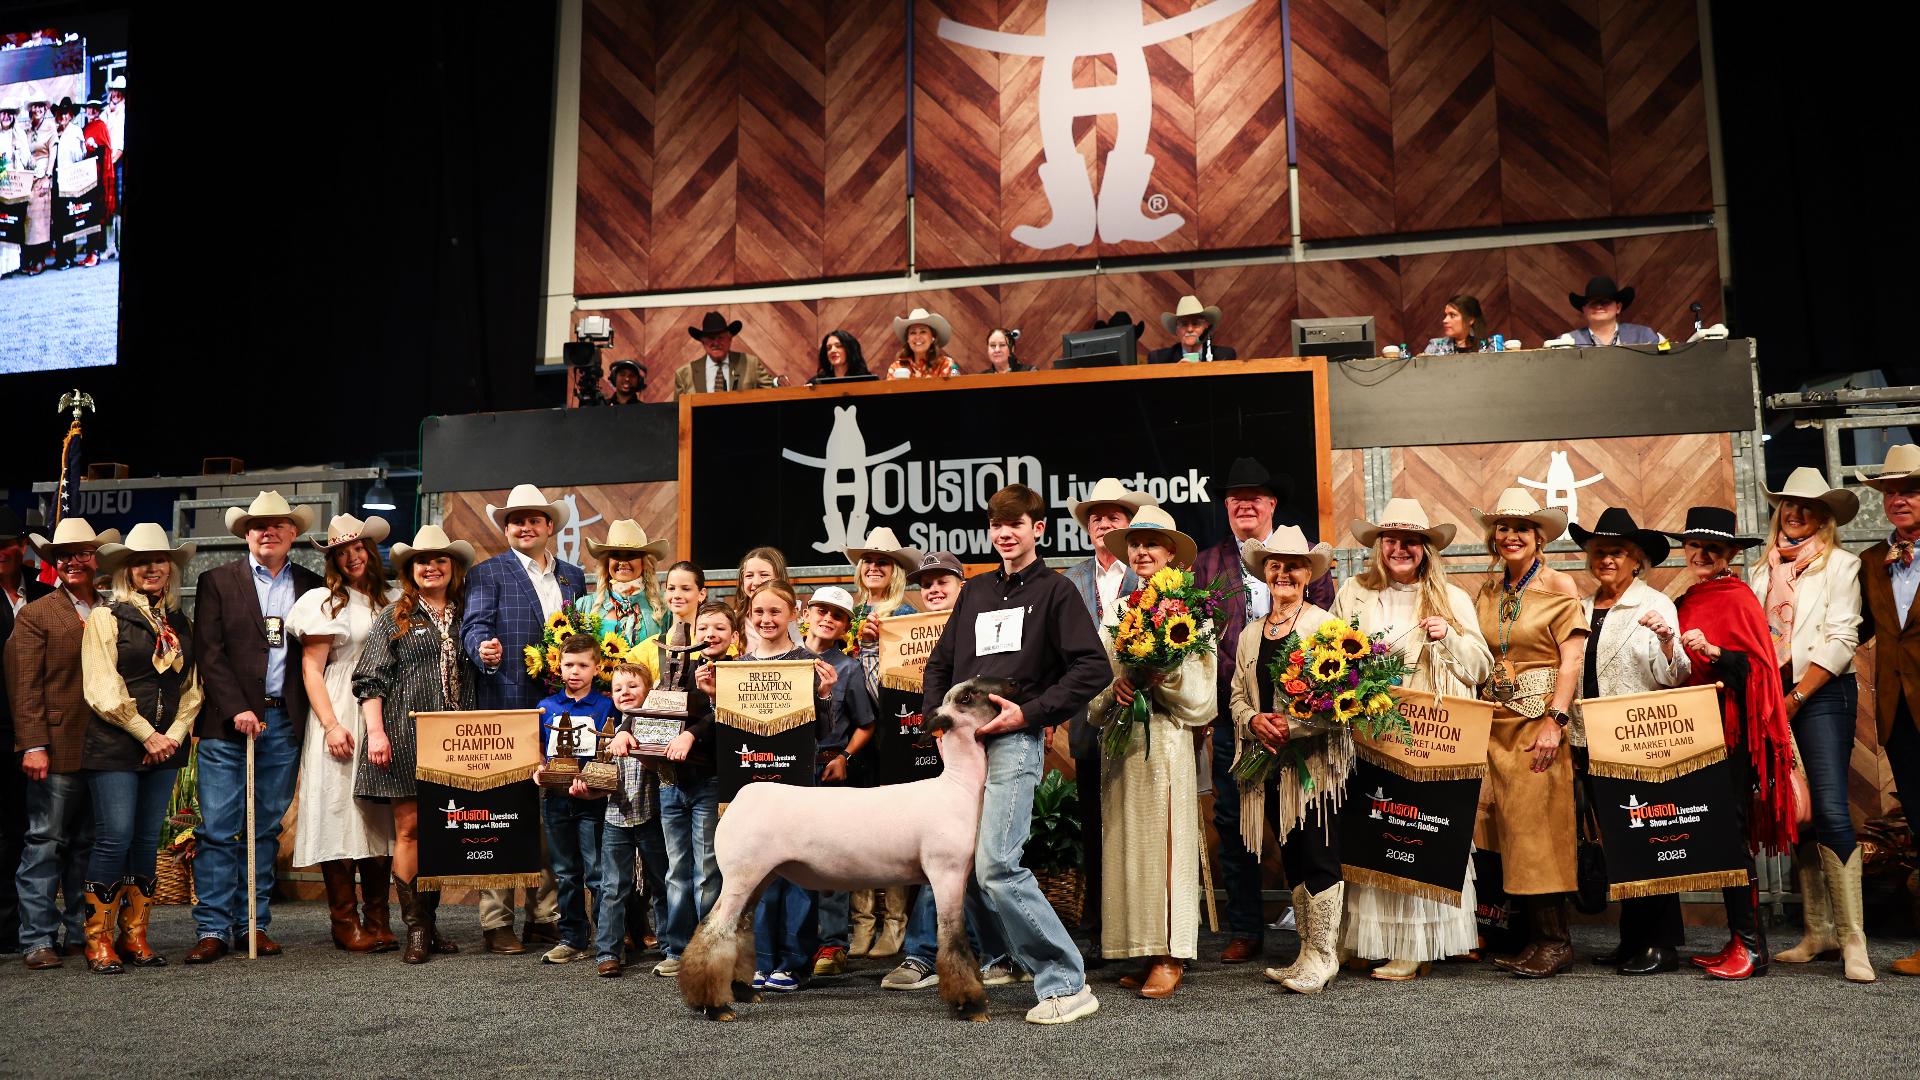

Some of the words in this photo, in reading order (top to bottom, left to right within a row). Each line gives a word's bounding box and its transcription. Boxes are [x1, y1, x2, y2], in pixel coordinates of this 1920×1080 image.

[1050, 469, 1211, 508] Livstock
[80, 489, 132, 514] DEO
[909, 521, 992, 556] Show
[910, 624, 947, 640] GRAN
[899, 640, 938, 656] CHAM
[911, 656, 928, 666] MAR
[749, 671, 782, 682] BREED
[738, 681, 793, 692] CHAMPION
[737, 693, 769, 702] MEDIUM
[770, 692, 793, 701] WOOL
[1397, 702, 1450, 724] GRAND
[1626, 704, 1678, 723] GRAND
[455, 723, 502, 737] GRAND
[1406, 719, 1462, 743] MPION
[1614, 717, 1695, 741] CHAMPION
[442, 736, 515, 752] CHAMPION
[1383, 733, 1395, 744] JR.
[1396, 735, 1430, 749] MRKET
[1430, 741, 1457, 755] LAMB
[1620, 743, 1633, 753] JR.
[1633, 738, 1669, 752] MARKET
[1669, 736, 1695, 748] LAMB
[445, 754, 456, 763] JR.
[457, 753, 489, 762] MARKET
[490, 752, 513, 761] LAMB
[914, 755, 938, 766] 2025
[1404, 747, 1431, 760] SHOW
[1645, 749, 1671, 760] SHOW
[467, 762, 491, 771] SHOW
[1676, 803, 1709, 815] Livestock
[489, 812, 519, 821] Livestock
[1417, 811, 1451, 827] Livestock
[1649, 818, 1668, 828] Show
[1678, 814, 1701, 825] Rodeo
[463, 822, 480, 830] Show
[490, 820, 510, 829] Rodeo
[1387, 815, 1406, 827] Show
[1417, 821, 1439, 833] Rodeo
[466, 850, 494, 860] 2025
[1385, 848, 1415, 863] 2025
[1657, 848, 1687, 862] 2025
